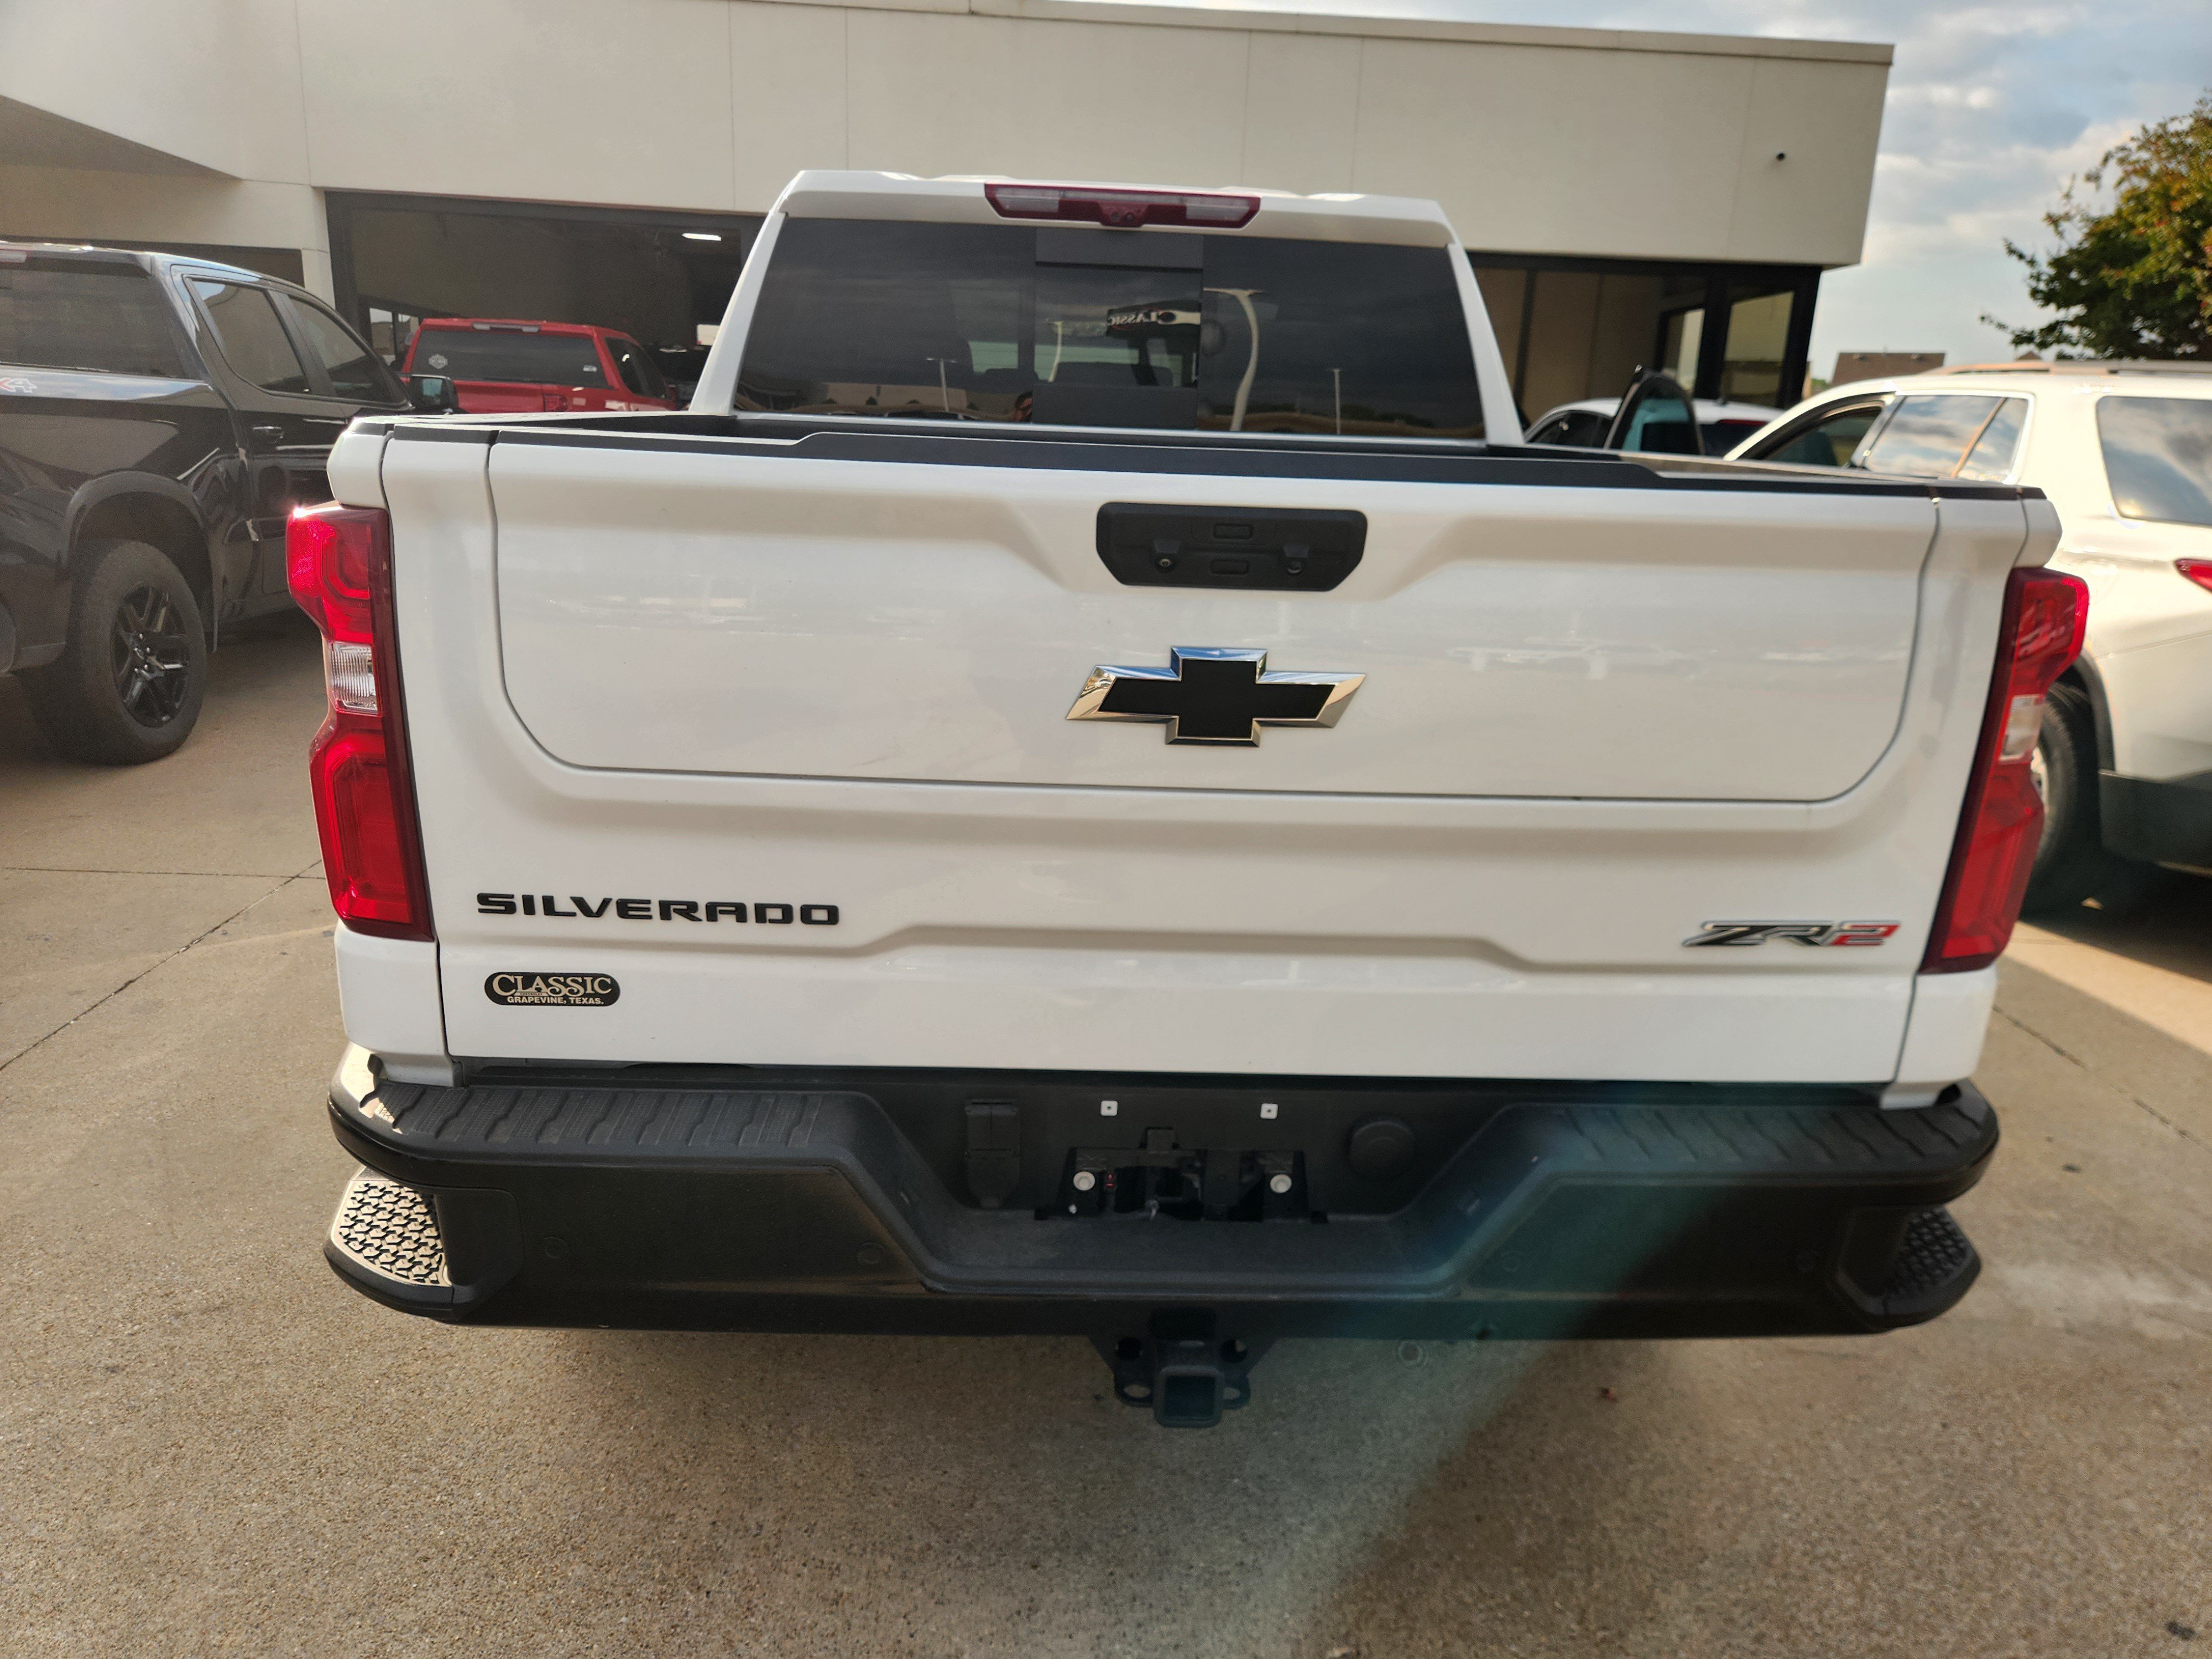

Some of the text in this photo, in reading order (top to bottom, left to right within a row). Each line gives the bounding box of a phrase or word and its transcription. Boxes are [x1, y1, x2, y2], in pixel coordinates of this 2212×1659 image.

[477, 893, 839, 925] SILVERADO
[1682, 920, 1901, 946] ZR2
[493, 974, 612, 997] CLASSIC
[569, 997, 604, 1005] TEXAS.
